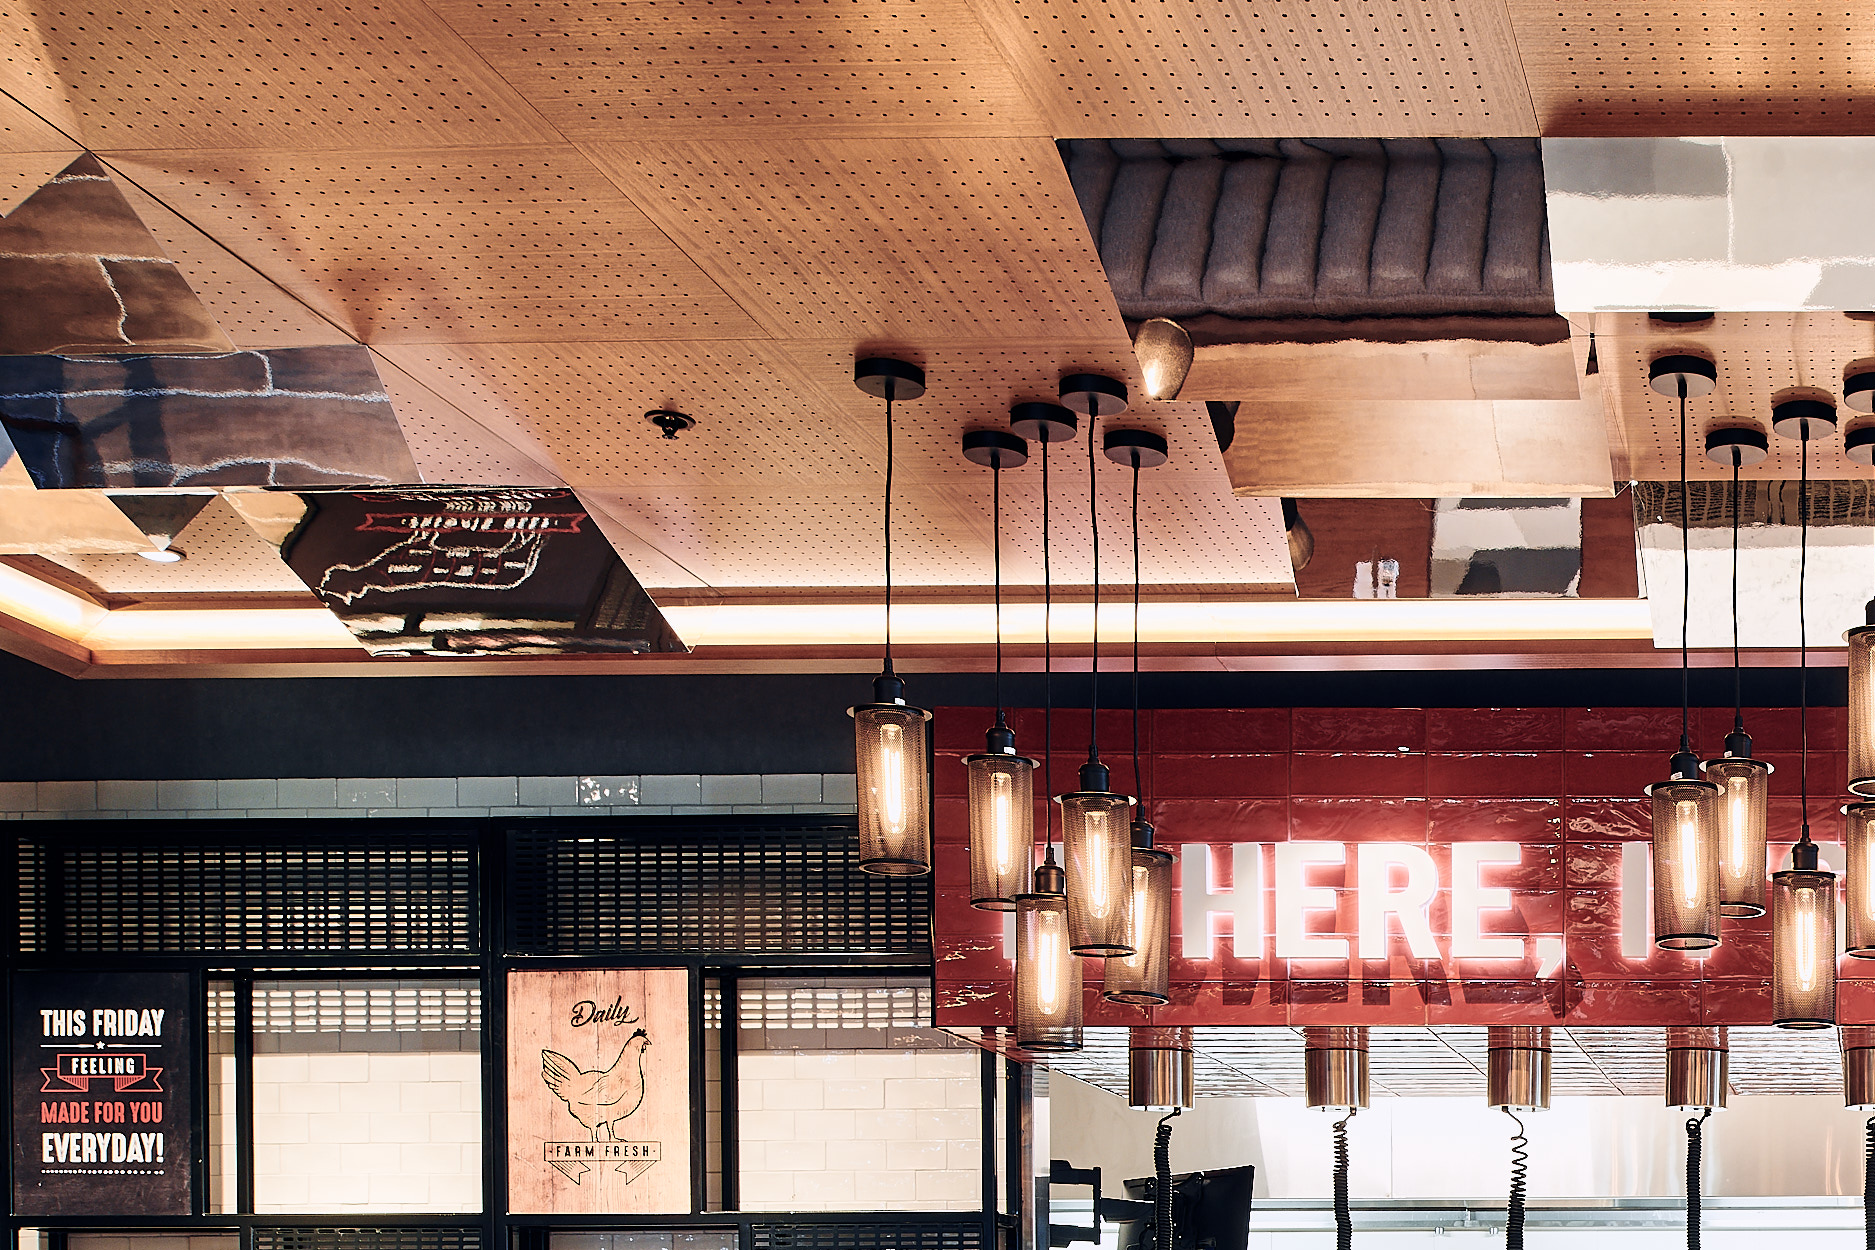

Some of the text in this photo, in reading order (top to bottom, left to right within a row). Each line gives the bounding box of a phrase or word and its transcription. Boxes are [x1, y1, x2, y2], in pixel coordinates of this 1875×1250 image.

[1181, 841, 1563, 979] HERE,
[41, 1009, 164, 1037] THIS FRIDAY
[570, 995, 640, 1027] Daily
[71, 1058, 135, 1076] FEELING
[41, 1102, 163, 1124] MADE FOR YOU
[42, 1133, 164, 1163] EVERYDAY!
[556, 1146, 649, 1157] FARM FRESH
